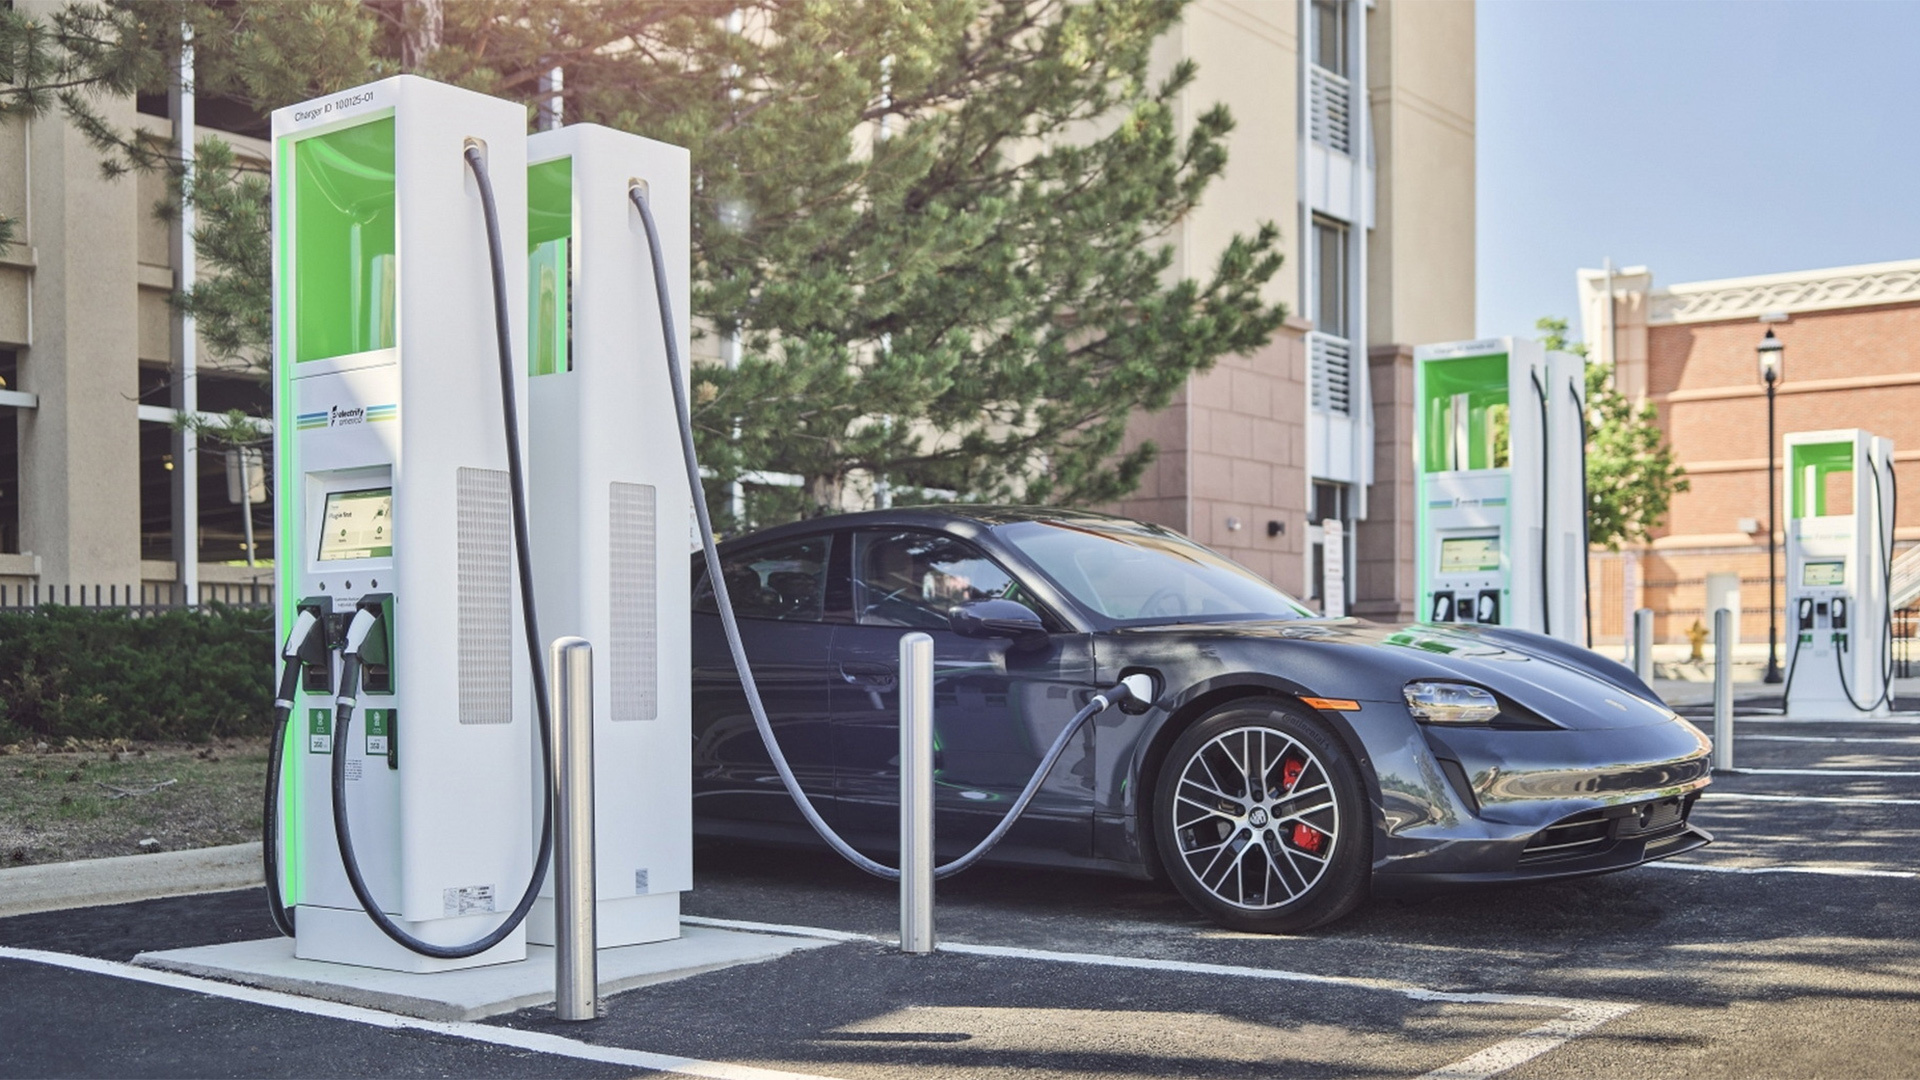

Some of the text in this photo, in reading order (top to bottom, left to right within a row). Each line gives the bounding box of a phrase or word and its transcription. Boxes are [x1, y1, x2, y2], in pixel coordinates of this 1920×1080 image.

[294, 92, 374, 122] Charger ID 100125-01
[1282, 713, 1326, 746] Continental
